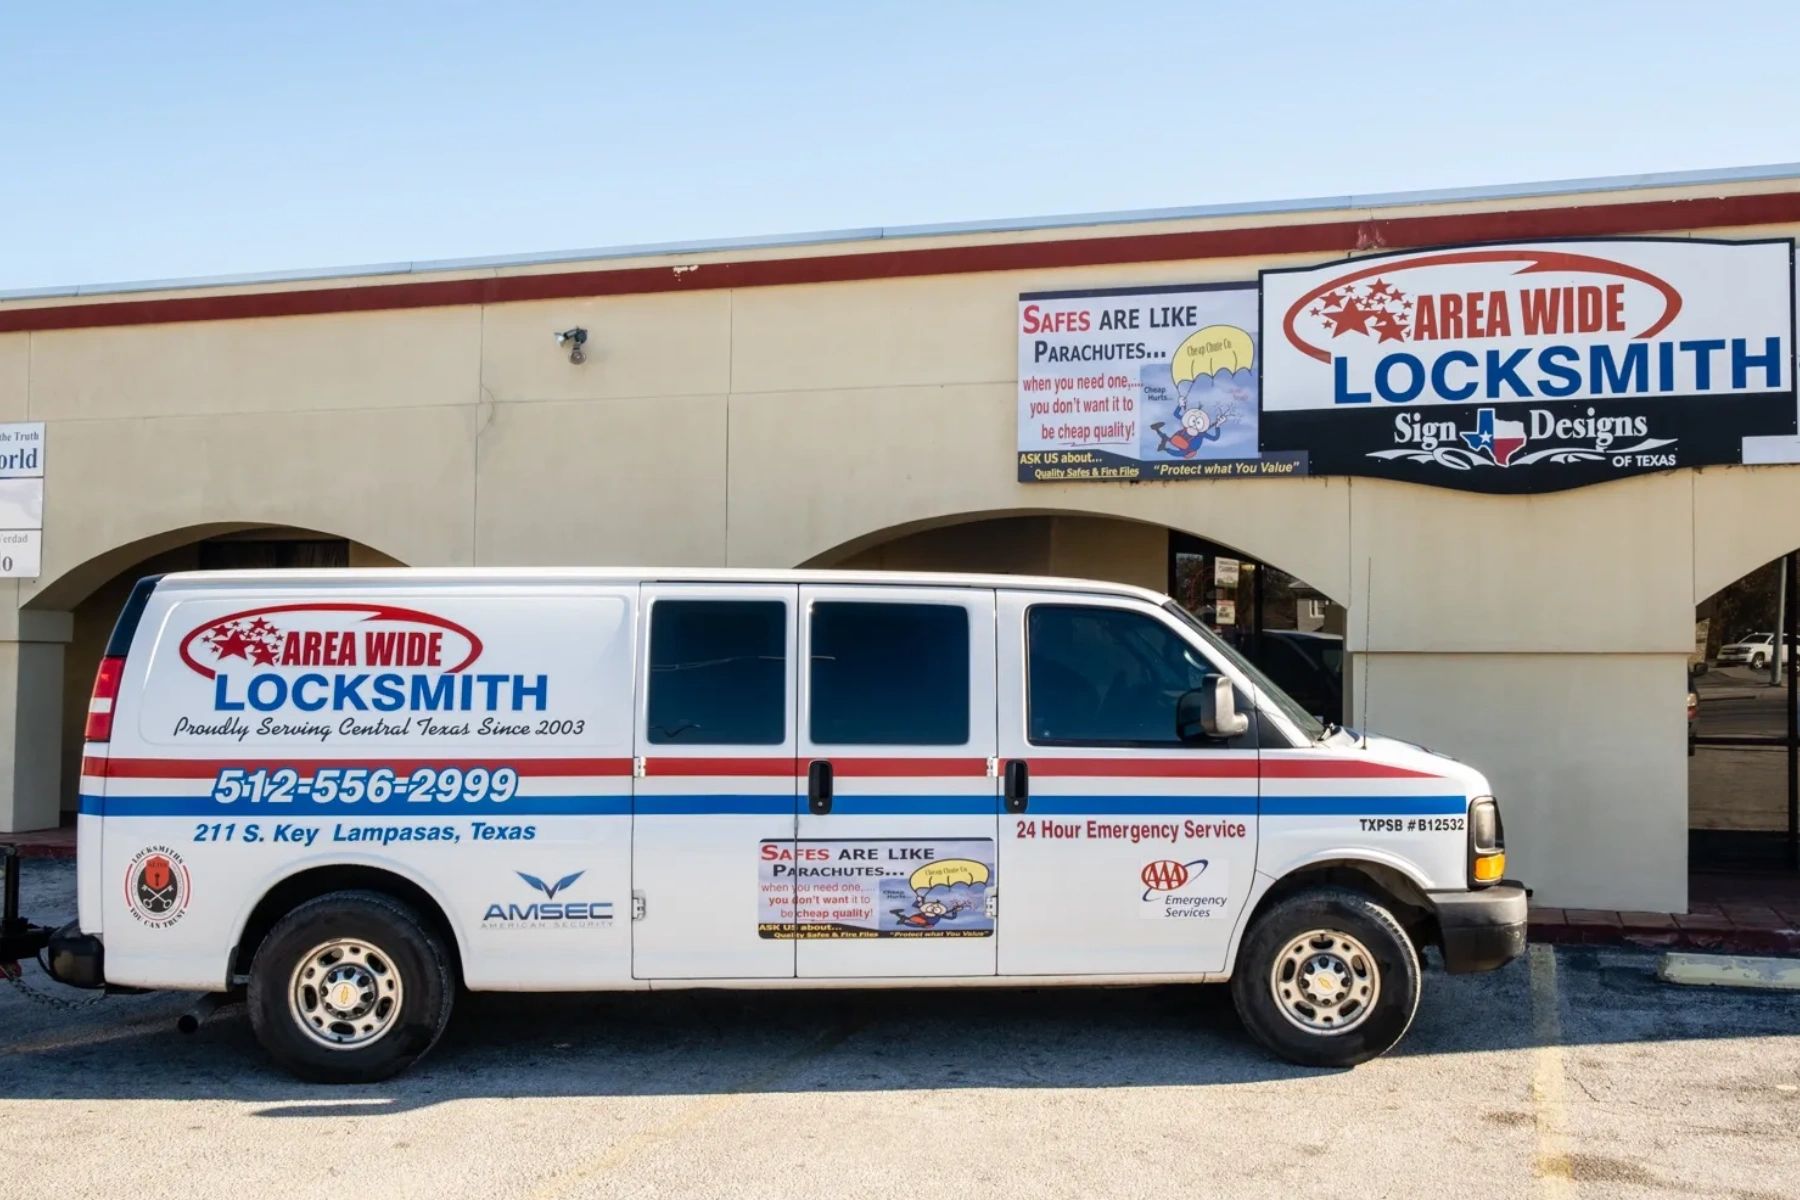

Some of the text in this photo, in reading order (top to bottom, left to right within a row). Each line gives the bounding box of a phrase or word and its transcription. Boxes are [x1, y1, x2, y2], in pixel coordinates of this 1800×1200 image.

[1099, 309, 1139, 330] ARE
[1149, 306, 1198, 328] LIKE
[1413, 283, 1626, 342] AREA WIDE
[1333, 336, 1782, 404] LOCKSMITH
[1023, 375, 1052, 392] when
[1054, 378, 1075, 393] you
[1077, 374, 1105, 390] need
[1144, 386, 1166, 396] Cheap
[1030, 396, 1133, 418] you don't want it to
[14, 431, 39, 441] Truth
[1041, 422, 1135, 443] be cheap quality!
[1394, 407, 1648, 450] Sign Designs
[1020, 452, 1102, 465] ASK US about...
[1612, 453, 1676, 468] OF TEXAS
[1035, 466, 1139, 480] Quality Safes & Fire Files
[1204, 463, 1232, 475] what
[1235, 462, 1258, 474] You
[281, 631, 442, 667] AREA WIDE
[215, 673, 548, 711] LOCKSMITH
[173, 716, 585, 742] Proudly Serving Central Texas Since 2003
[213, 767, 519, 804] 512-556-2999
[194, 822, 536, 847] 211 S. Key Lampasas, Texas
[1016, 820, 1247, 843] 24 Hour Emergency Service
[1359, 818, 1403, 833] TXPSB
[131, 845, 185, 864] LOCKSMITHS
[838, 849, 879, 860] ARE
[888, 849, 934, 860] LIKE
[1145, 864, 1189, 890] AAA
[761, 883, 789, 892] when
[813, 883, 840, 892] need
[769, 897, 788, 907] you
[822, 896, 849, 904] want
[851, 895, 859, 904] it
[860, 896, 871, 904] to
[1165, 895, 1228, 907] Emergency
[144, 919, 161, 929] CAN
[163, 909, 186, 928] TRUST
[483, 902, 614, 921] AMSEC
[780, 908, 873, 920] be cheap quality!
[1165, 906, 1211, 918] Services
[553, 921, 614, 929] SECURITY
